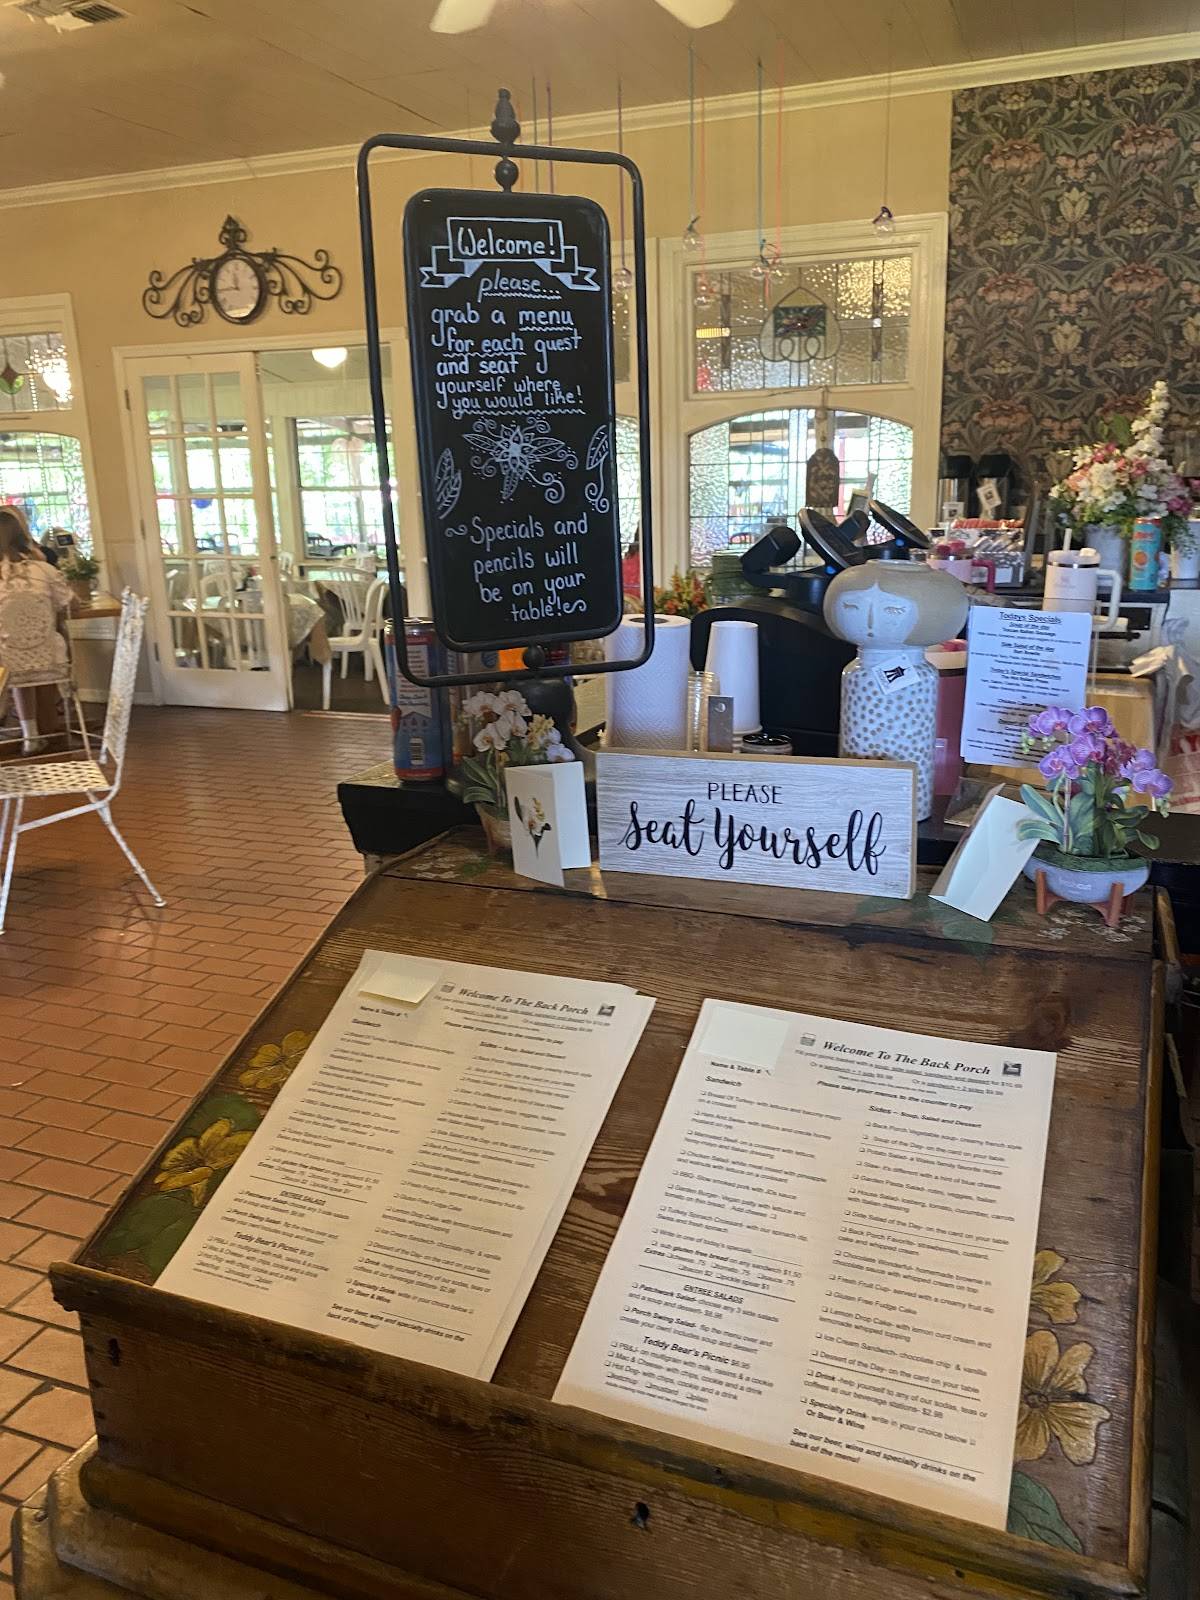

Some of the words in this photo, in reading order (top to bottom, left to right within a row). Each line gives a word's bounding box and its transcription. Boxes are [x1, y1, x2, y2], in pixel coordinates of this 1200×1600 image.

[458, 226, 556, 256] Welcome!
[478, 268, 559, 303] please...
[432, 302, 480, 346] grab
[491, 310, 505, 324] a
[519, 310, 574, 325] menu
[437, 355, 469, 376] and
[480, 354, 519, 374] seat
[447, 327, 474, 352] for
[482, 332, 524, 352] each
[535, 329, 582, 374] guest
[436, 377, 504, 409] yourself
[514, 376, 561, 393] where
[453, 396, 480, 419] you
[486, 393, 533, 408] would
[545, 385, 583, 405] like!
[470, 515, 544, 551] Specials
[554, 512, 588, 535] and
[474, 547, 535, 582] pencils
[546, 542, 578, 567] will
[480, 583, 502, 603] be
[513, 581, 534, 596] on
[544, 572, 586, 605] your
[511, 597, 562, 622] table!
[707, 782, 783, 805] PLEASE
[618, 799, 705, 856] Seat
[457, 987, 499, 1001] Welcome
[499, 994, 514, 1003] To
[514, 997, 531, 1006] The
[530, 999, 559, 1010] Back
[558, 1003, 590, 1014] Porch
[822, 1040, 874, 1057] Welcome
[876, 1050, 892, 1060] To
[894, 1053, 917, 1064] The
[919, 1057, 951, 1069] Back
[953, 1061, 991, 1074] Porch
[683, 1283, 713, 1296] ENTREE
[712, 1290, 744, 1304] SALADS
[641, 1335, 670, 1351] Teddy
[670, 1342, 701, 1357] Bear's
[700, 1350, 730, 1364] Picnic
[805, 1407, 816, 1417] Or
[816, 1410, 837, 1422] Beer
[836, 1415, 844, 1424] &
[845, 1418, 865, 1430] Wine
